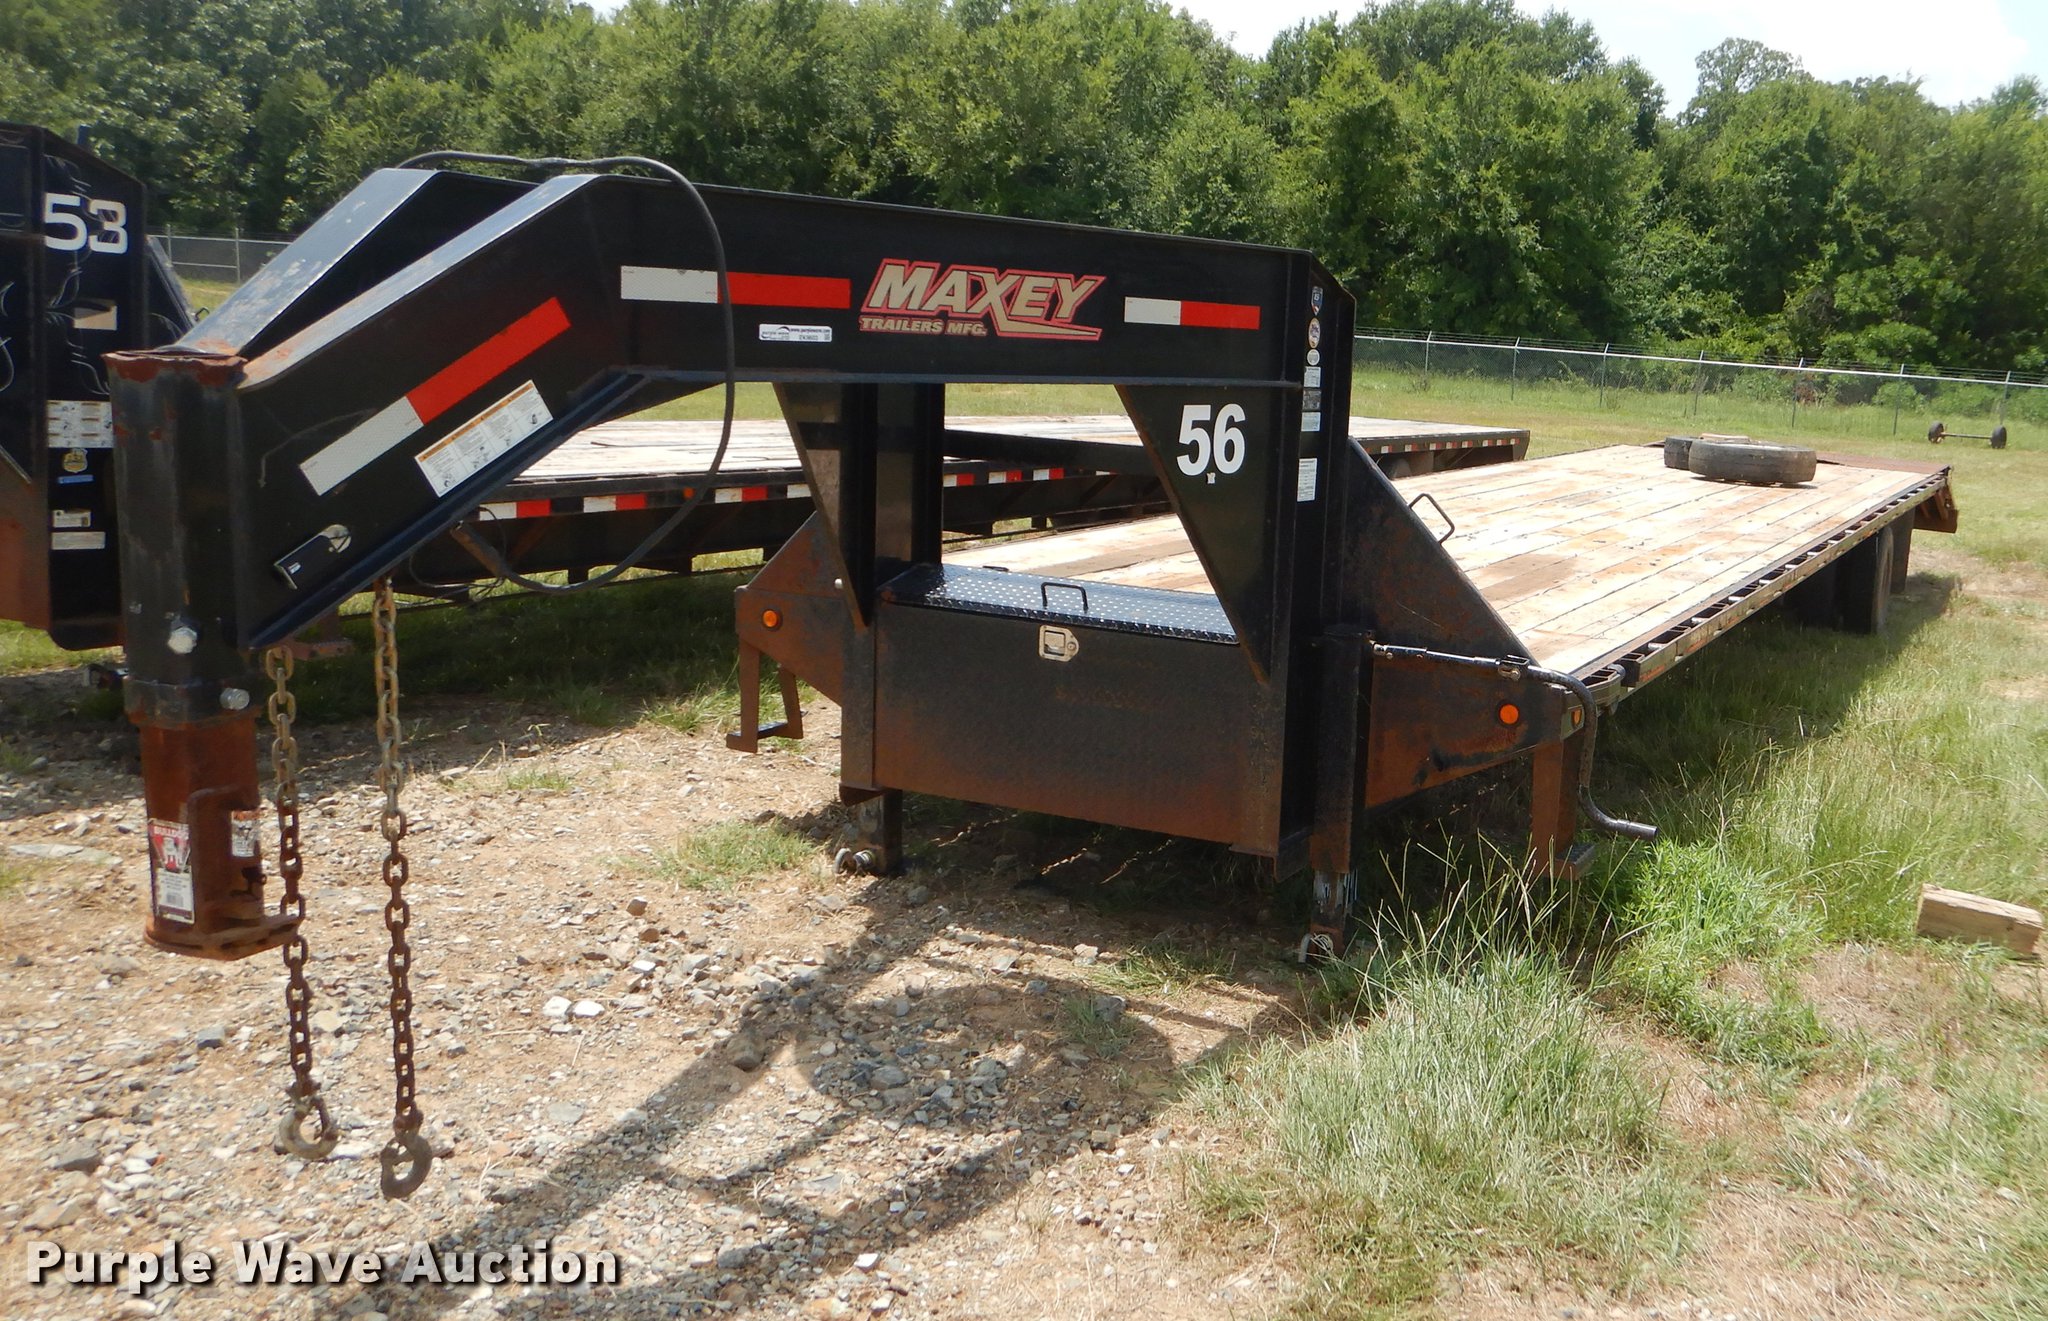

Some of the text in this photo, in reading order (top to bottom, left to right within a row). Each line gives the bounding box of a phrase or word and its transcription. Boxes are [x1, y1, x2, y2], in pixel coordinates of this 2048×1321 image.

[44, 192, 128, 254] 53
[860, 315, 987, 337] TRAILERS MFG.
[861, 259, 1106, 340] MAXEY
[1177, 403, 1246, 476] 56
